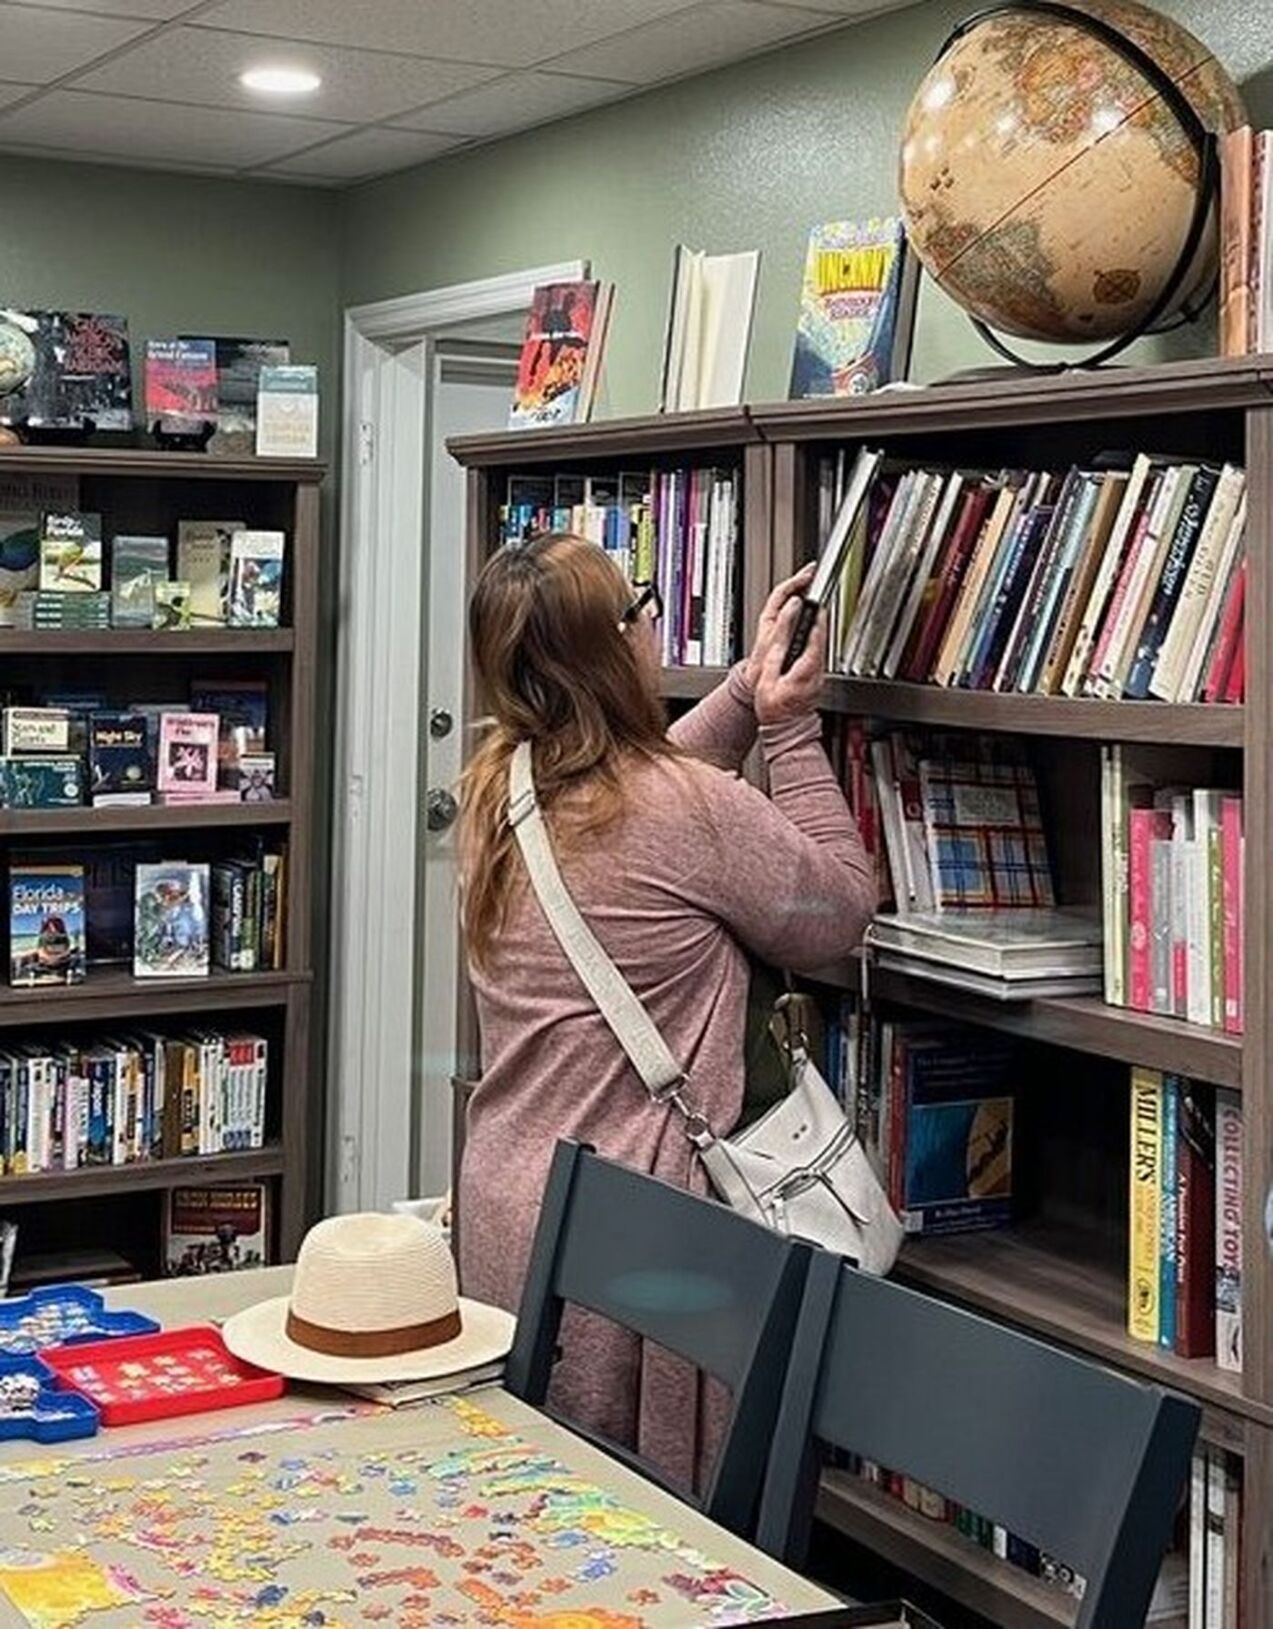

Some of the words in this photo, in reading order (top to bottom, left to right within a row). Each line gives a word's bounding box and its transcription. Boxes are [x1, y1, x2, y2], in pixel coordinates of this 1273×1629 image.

[95, 730, 122, 746] Night
[124, 730, 143, 744] Sky
[12, 884, 64, 900] Florida
[12, 902, 39, 915] DAY
[41, 902, 81, 915] TRIPS
[1134, 1085, 1158, 1184] MILLER'S
[1222, 1108, 1241, 1222] COLLECTING
